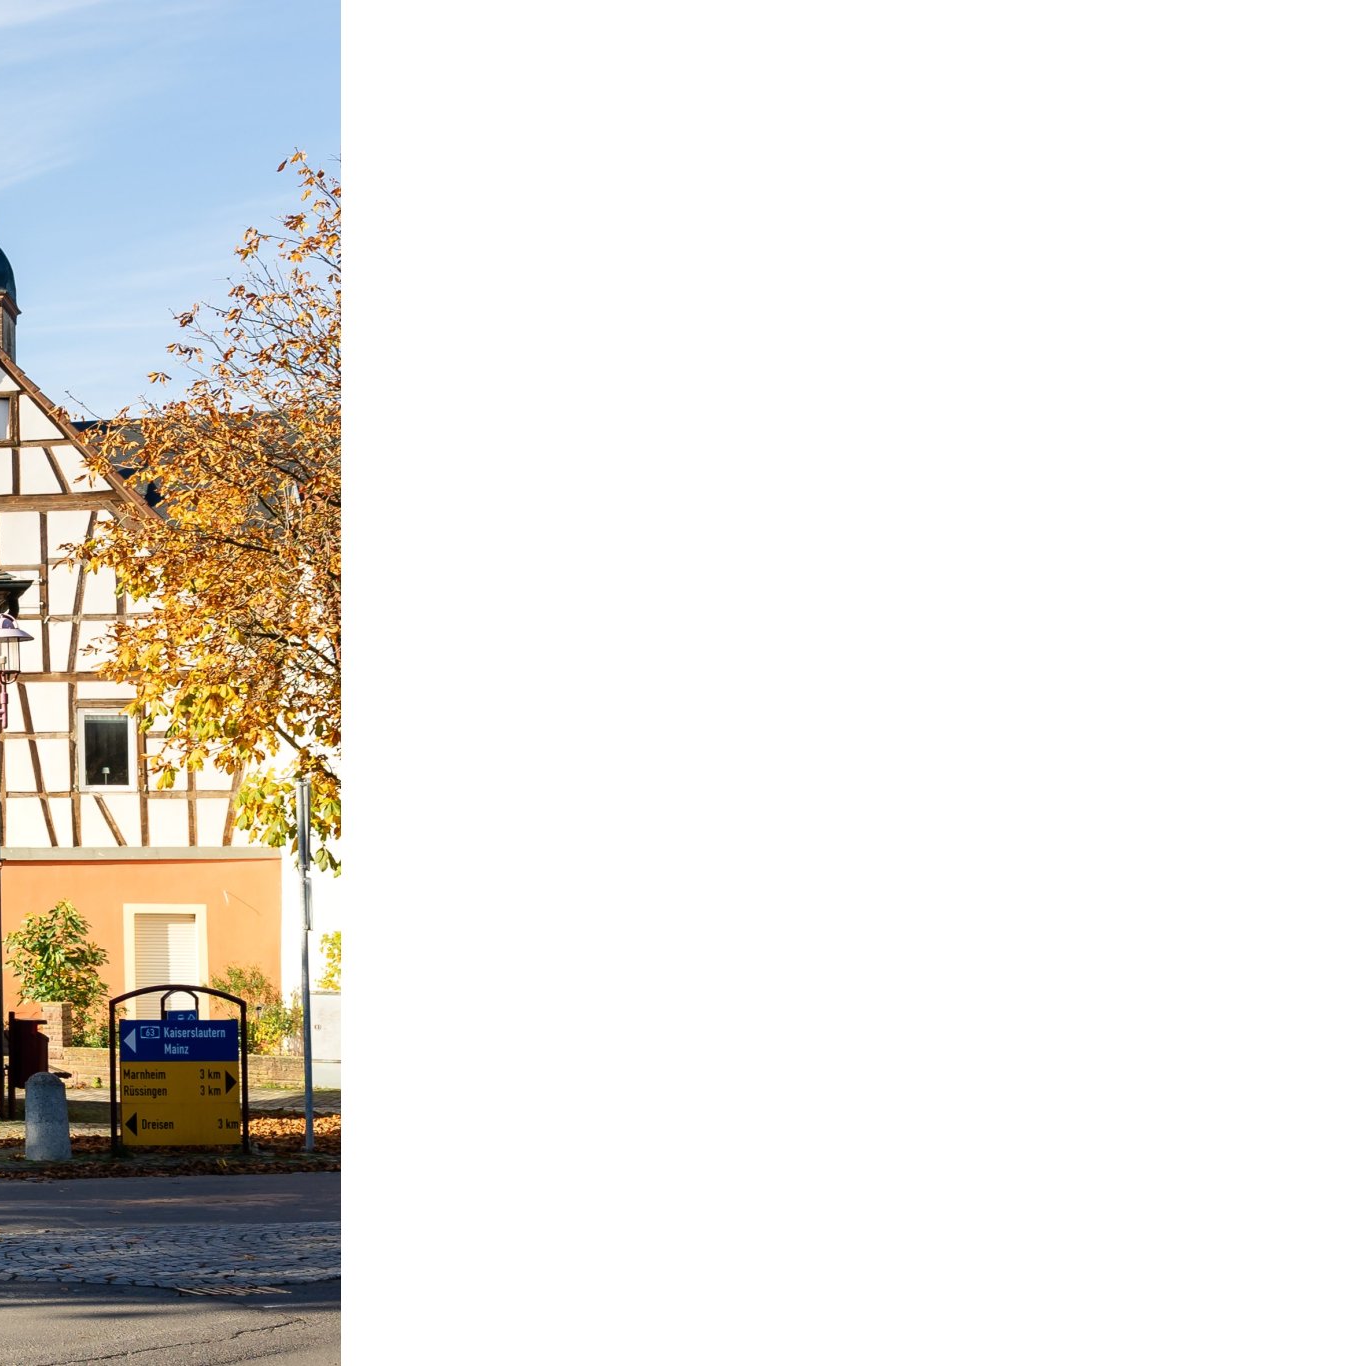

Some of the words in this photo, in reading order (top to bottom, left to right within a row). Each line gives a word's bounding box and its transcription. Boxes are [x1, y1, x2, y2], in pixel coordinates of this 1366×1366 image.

[145, 1029, 155, 1037] 63
[163, 1027, 226, 1038] Kaiserslautern
[164, 1043, 189, 1055] Mainz
[123, 1069, 166, 1080] Marnheim
[199, 1069, 205, 1079] 3
[208, 1069, 221, 1079] km
[123, 1085, 168, 1099] Rüssingen
[200, 1085, 206, 1096] 3
[208, 1085, 221, 1096] km
[141, 1118, 174, 1130] Dreisen
[218, 1119, 223, 1130] 3
[225, 1119, 239, 1130] km
